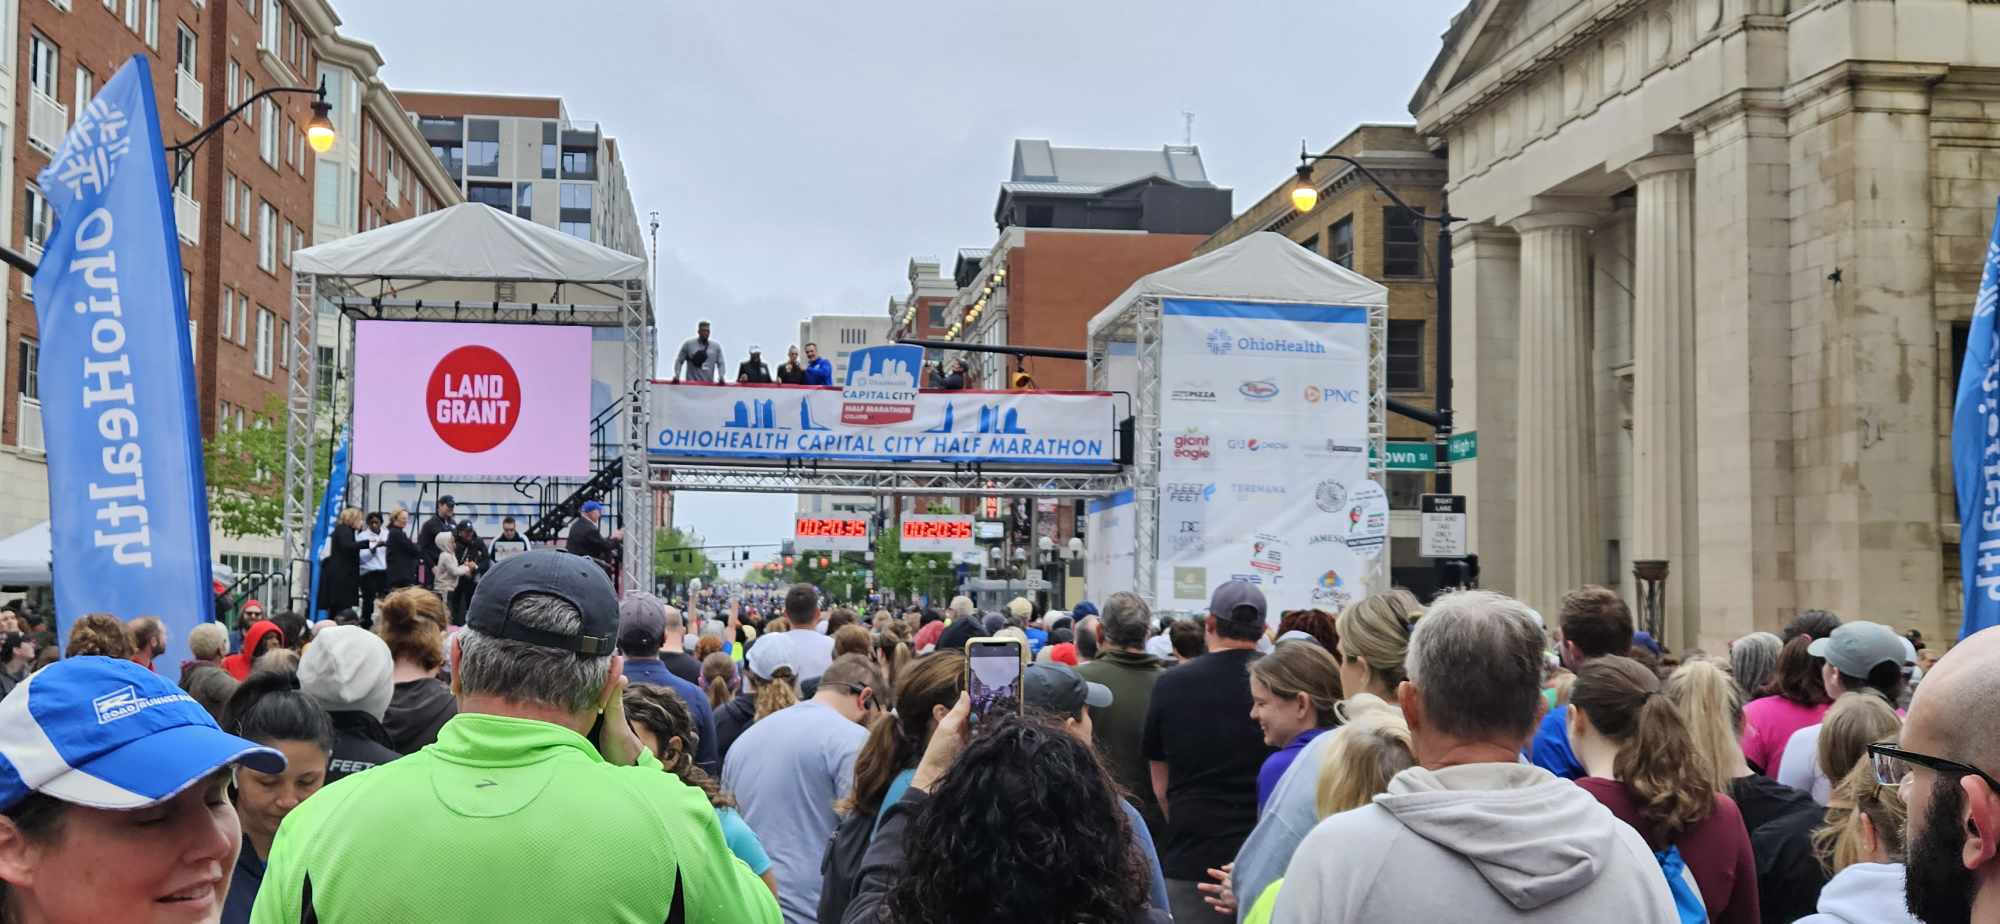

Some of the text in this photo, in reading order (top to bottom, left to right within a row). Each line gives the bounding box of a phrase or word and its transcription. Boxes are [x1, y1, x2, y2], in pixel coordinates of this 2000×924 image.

[1238, 337, 1326, 353] OhioHealth
[444, 373, 503, 398] LAND
[1324, 388, 1359, 404] PNC
[436, 399, 511, 424] GRANT
[658, 428, 1103, 456] OHIOHEALTH CAPITAL CITY HALF MARATHON
[1174, 434, 1209, 448] giant
[1174, 448, 1210, 461] eagle
[1384, 451, 1416, 463] own
[904, 521, 971, 538] 00:20:35
[1309, 534, 1345, 545] JAMESO
[102, 704, 136, 720] ROAD
